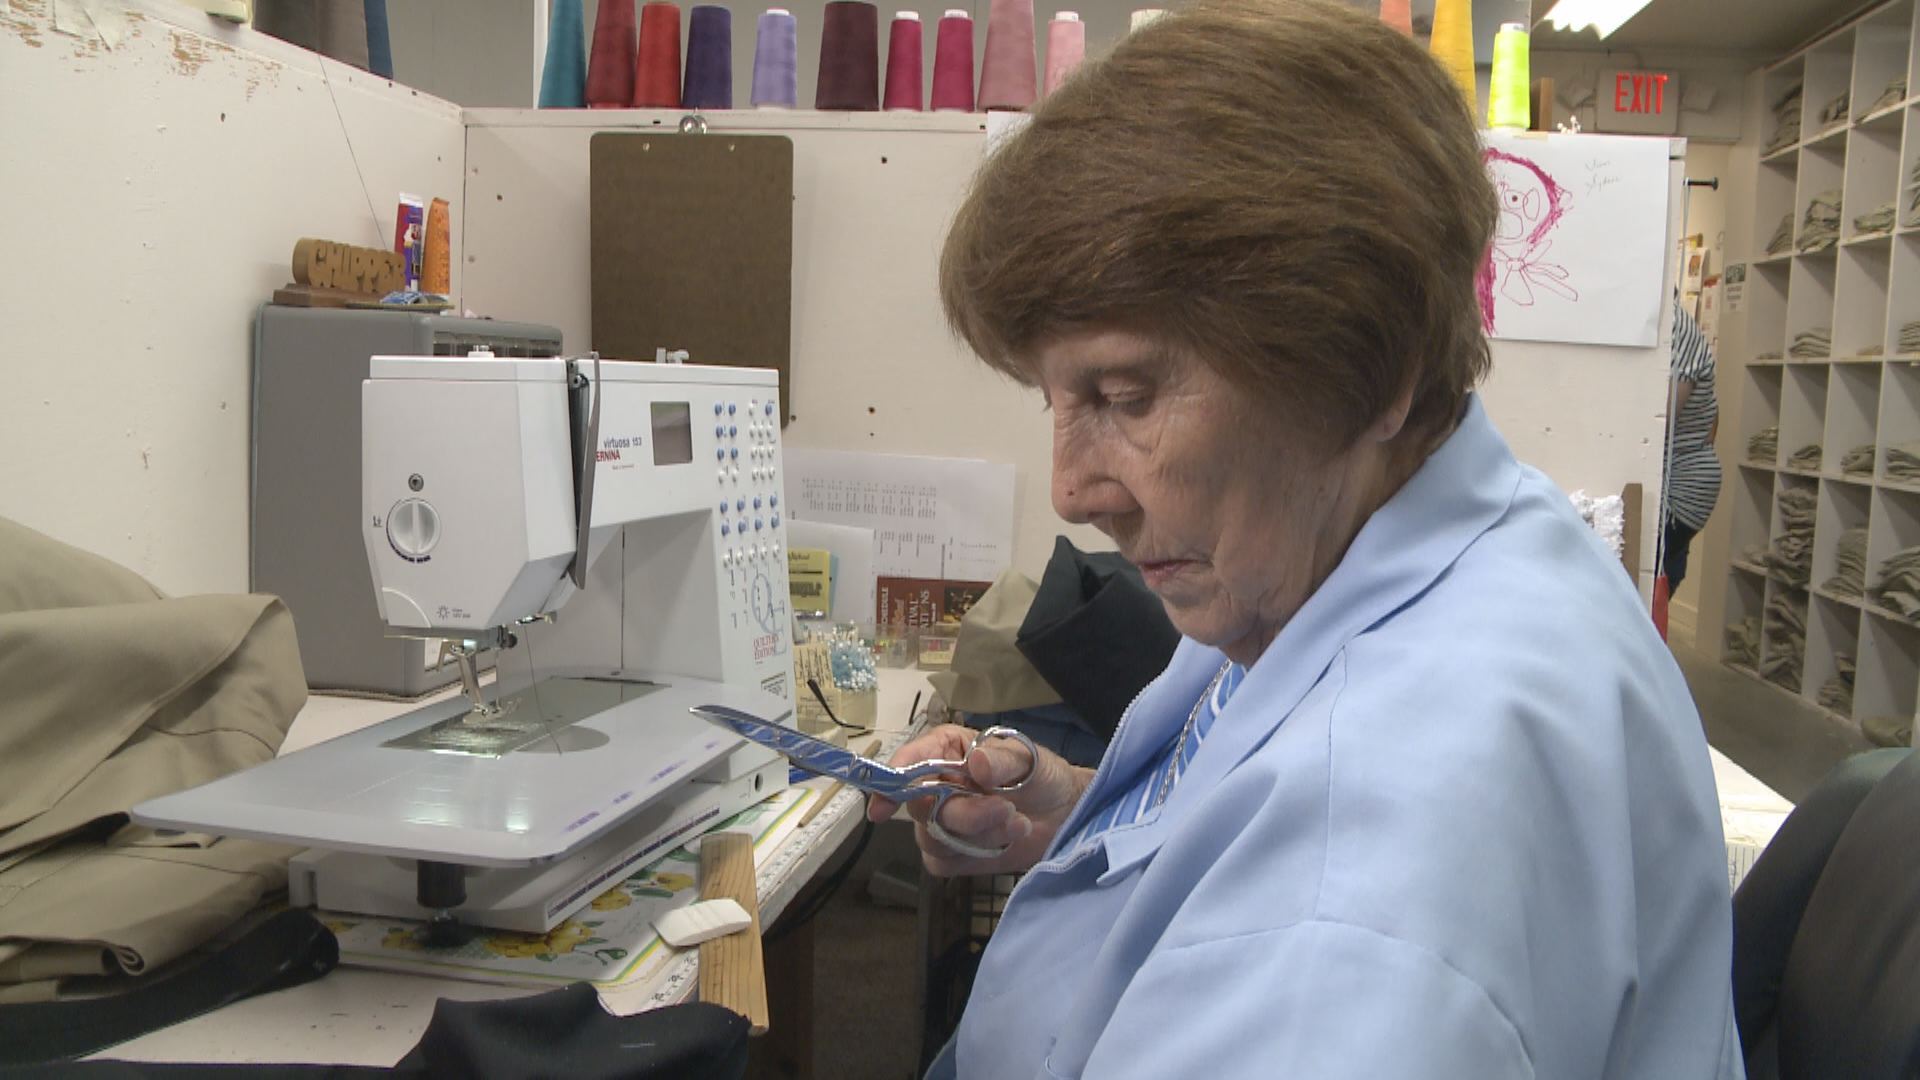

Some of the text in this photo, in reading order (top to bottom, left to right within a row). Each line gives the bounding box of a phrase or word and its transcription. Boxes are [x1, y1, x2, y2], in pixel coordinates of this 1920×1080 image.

[1614, 72, 1669, 115] EXIT
[603, 436, 642, 449] virtuosa 153
[596, 450, 621, 462] ERNINA
